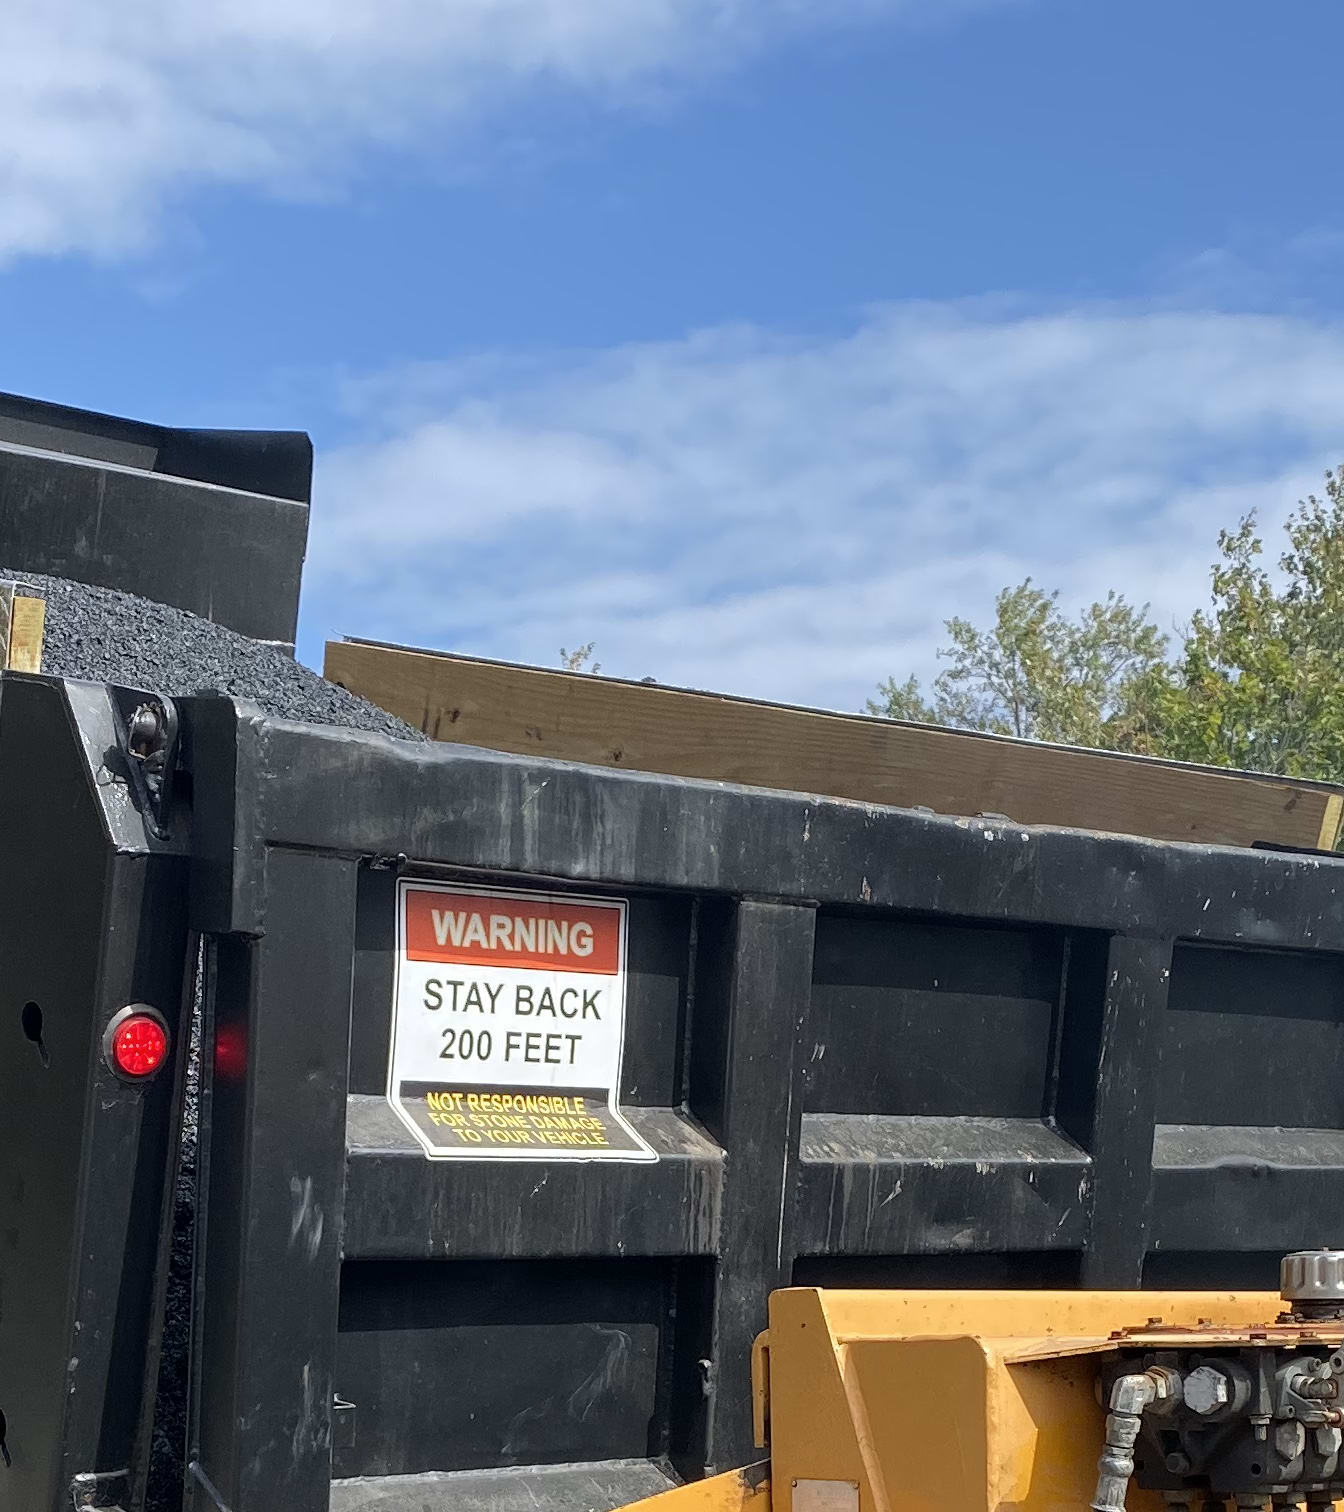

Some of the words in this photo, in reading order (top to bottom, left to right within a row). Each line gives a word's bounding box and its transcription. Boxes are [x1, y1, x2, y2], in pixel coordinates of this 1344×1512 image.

[431, 908, 594, 957] WARNING
[423, 978, 504, 1014] STAY
[515, 985, 602, 1020] BACK
[439, 1028, 493, 1061] 200
[504, 1031, 583, 1064] FEET
[426, 1092, 464, 1112] NOT
[467, 1093, 587, 1115] RESPONSIBLE
[427, 1112, 471, 1128] FOR
[469, 1113, 532, 1129] STONE
[528, 1115, 608, 1131] DAMAGE
[452, 1128, 483, 1143] TO
[480, 1129, 536, 1145] YOUR
[531, 1131, 610, 1146] VEHICLE
